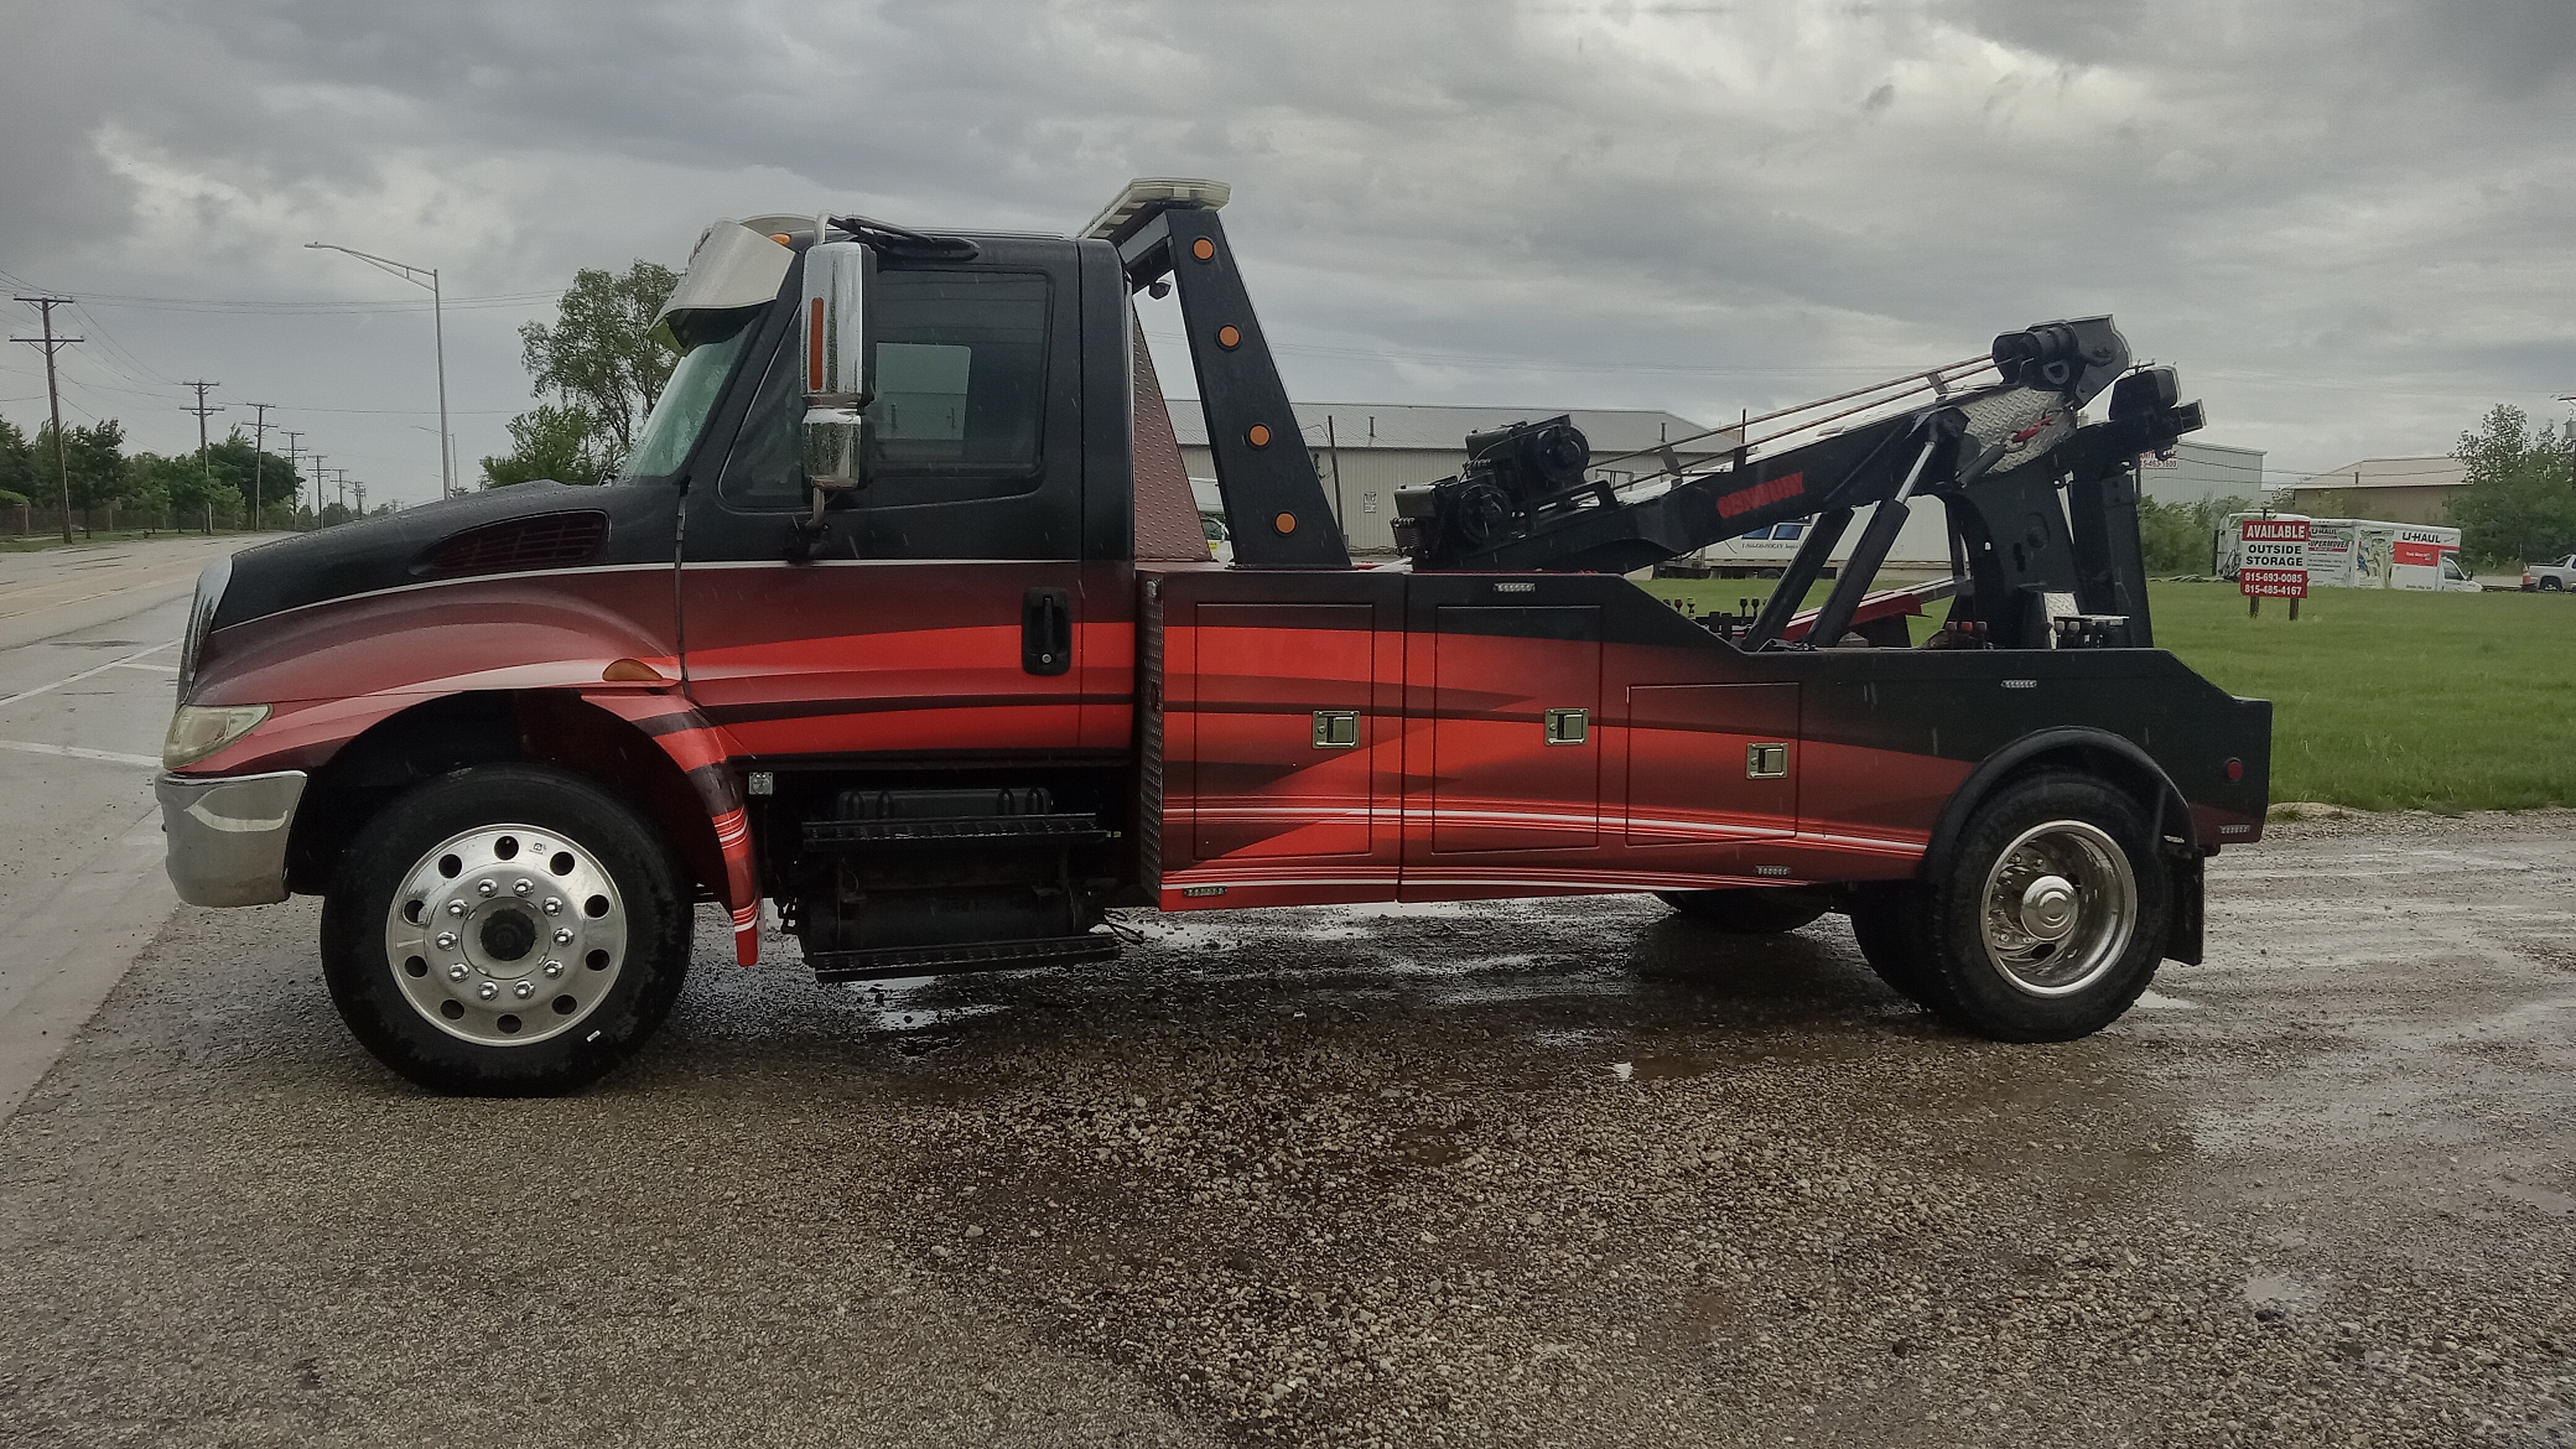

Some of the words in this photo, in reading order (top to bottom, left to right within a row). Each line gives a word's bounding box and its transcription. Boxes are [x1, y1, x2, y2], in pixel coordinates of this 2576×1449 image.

[2247, 524, 2305, 538] AVAILABLE
[2403, 532, 2440, 543] U-HAUL
[2248, 545, 2302, 554] OUTSIDE
[2246, 556, 2303, 567] STORAGE
[2245, 572, 2302, 583] 815-693-0085
[2245, 584, 2302, 595] 815-485-4167
